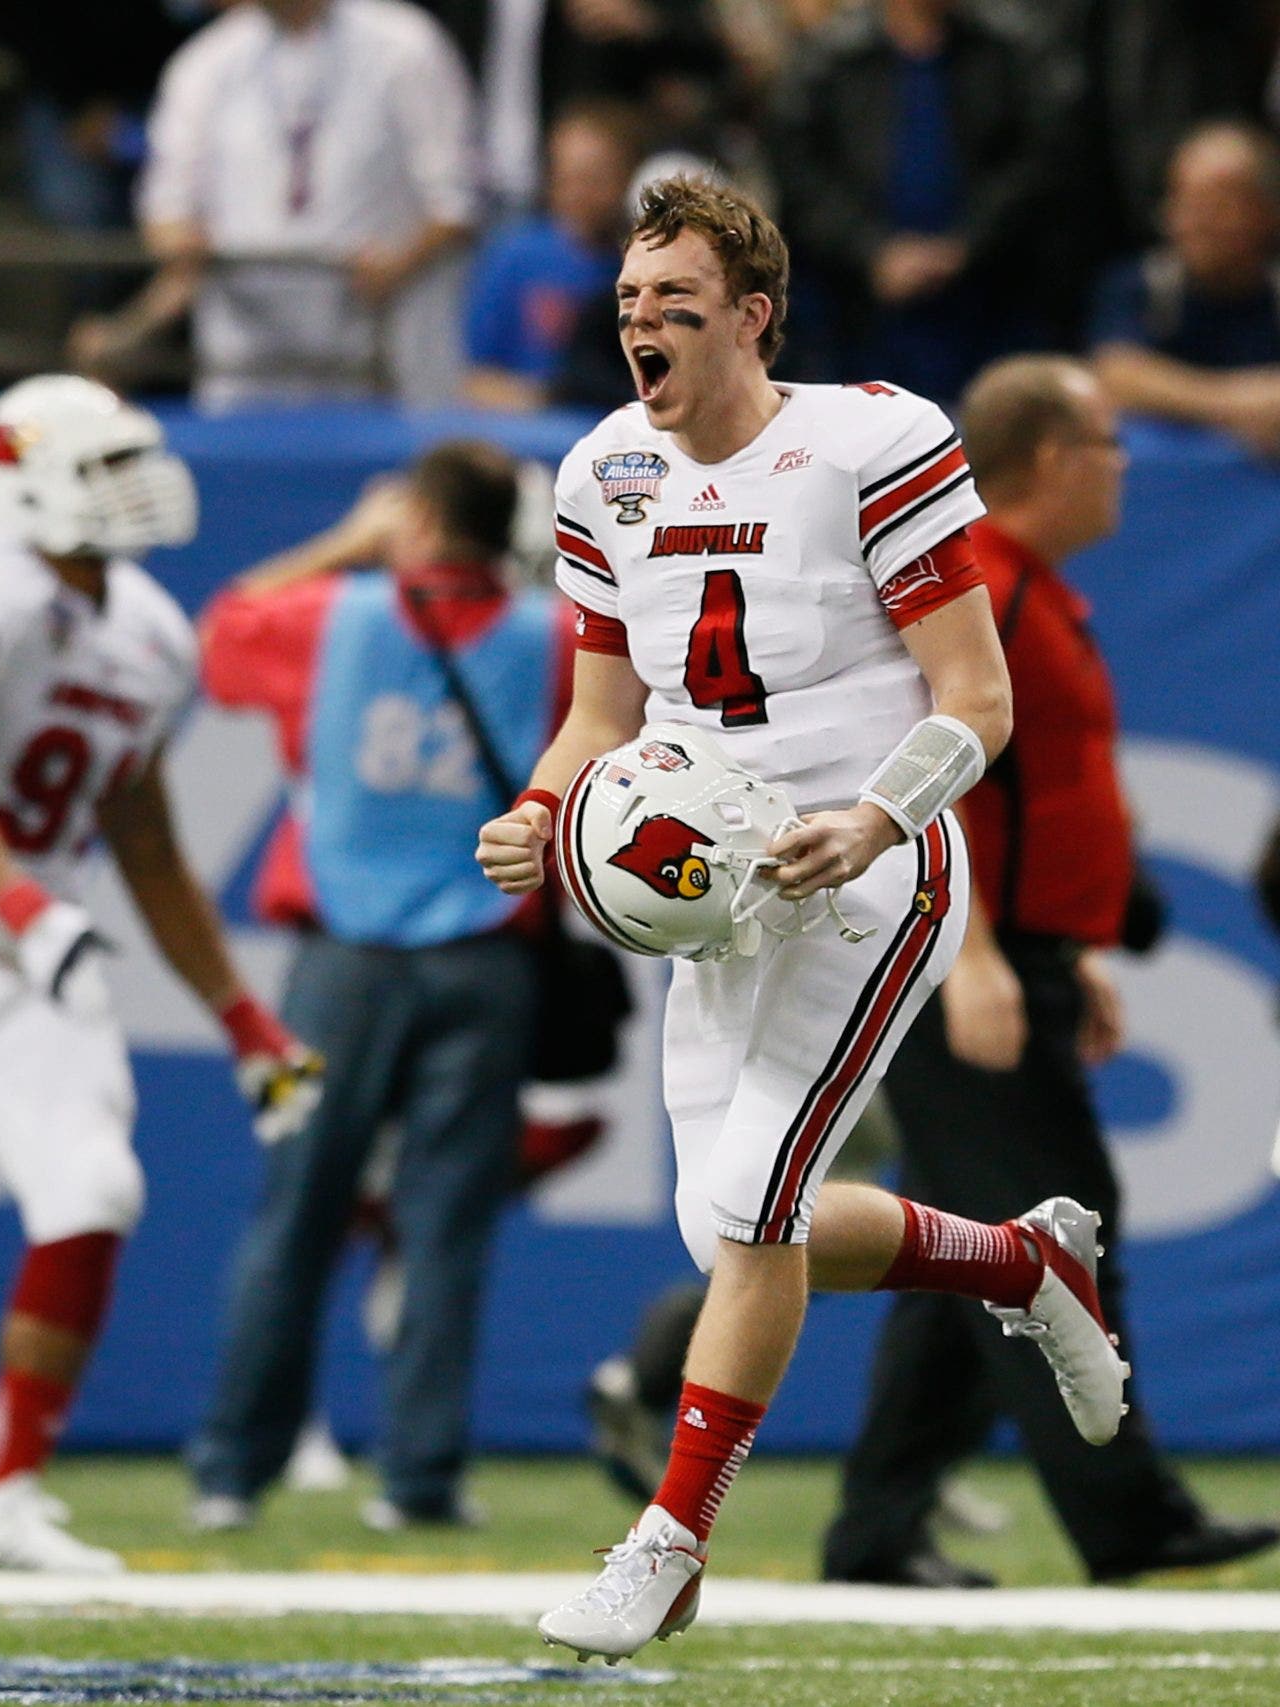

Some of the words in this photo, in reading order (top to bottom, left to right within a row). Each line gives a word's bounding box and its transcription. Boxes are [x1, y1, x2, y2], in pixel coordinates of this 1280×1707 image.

[773, 453, 814, 471] EAST
[780, 447, 807, 461] BIG
[604, 465, 660, 480] Allstate
[688, 501, 727, 513] adidas
[647, 522, 769, 559] LOUISVILLE
[683, 568, 769, 728] 4
[354, 690, 484, 797] 82
[644, 743, 687, 770] BCS
